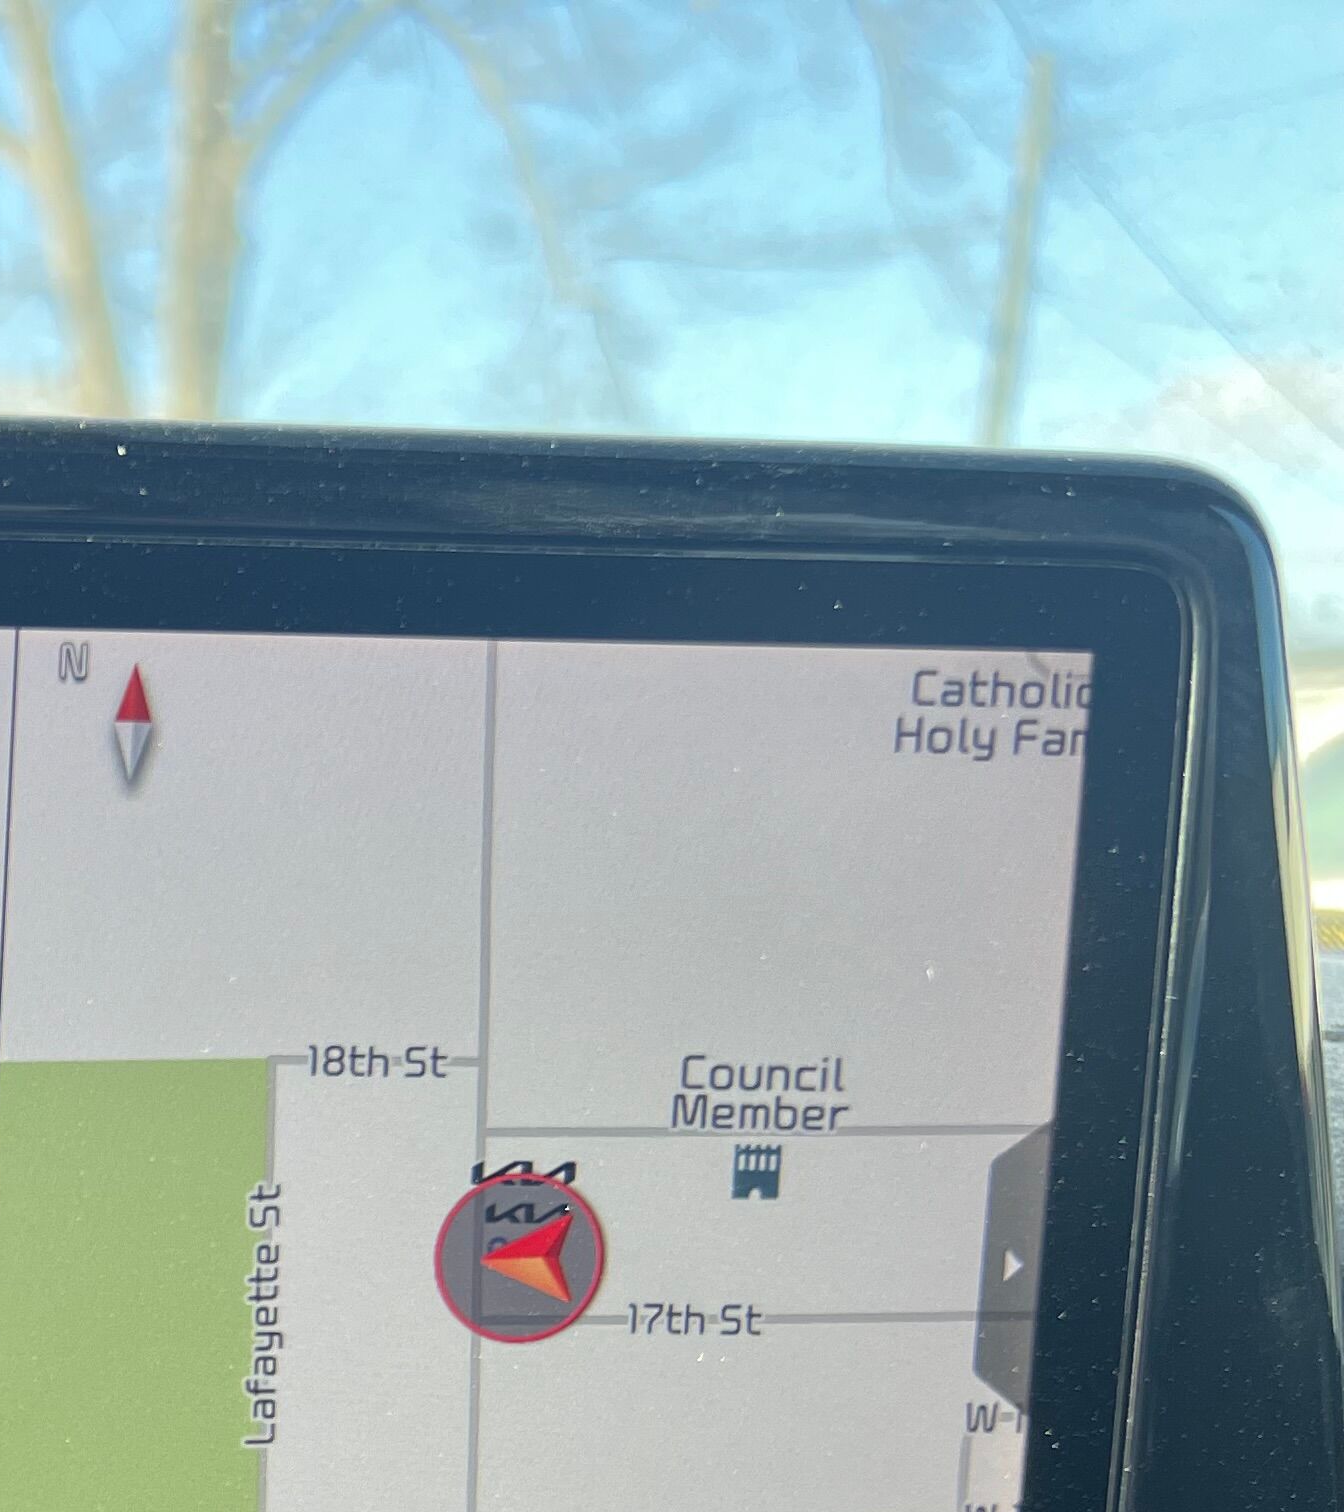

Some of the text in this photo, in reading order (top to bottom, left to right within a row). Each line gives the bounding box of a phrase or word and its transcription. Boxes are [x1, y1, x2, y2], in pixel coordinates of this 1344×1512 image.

[58, 642, 89, 682] N
[913, 669, 1092, 709] Catholic
[894, 716, 996, 761] Holy
[308, 1043, 448, 1081] 18th St
[680, 1054, 845, 1094] Council
[671, 1095, 850, 1134] Member
[245, 1180, 284, 1446] Lafayette St
[627, 1303, 764, 1340] 17th St
[966, 1402, 999, 1433] W
